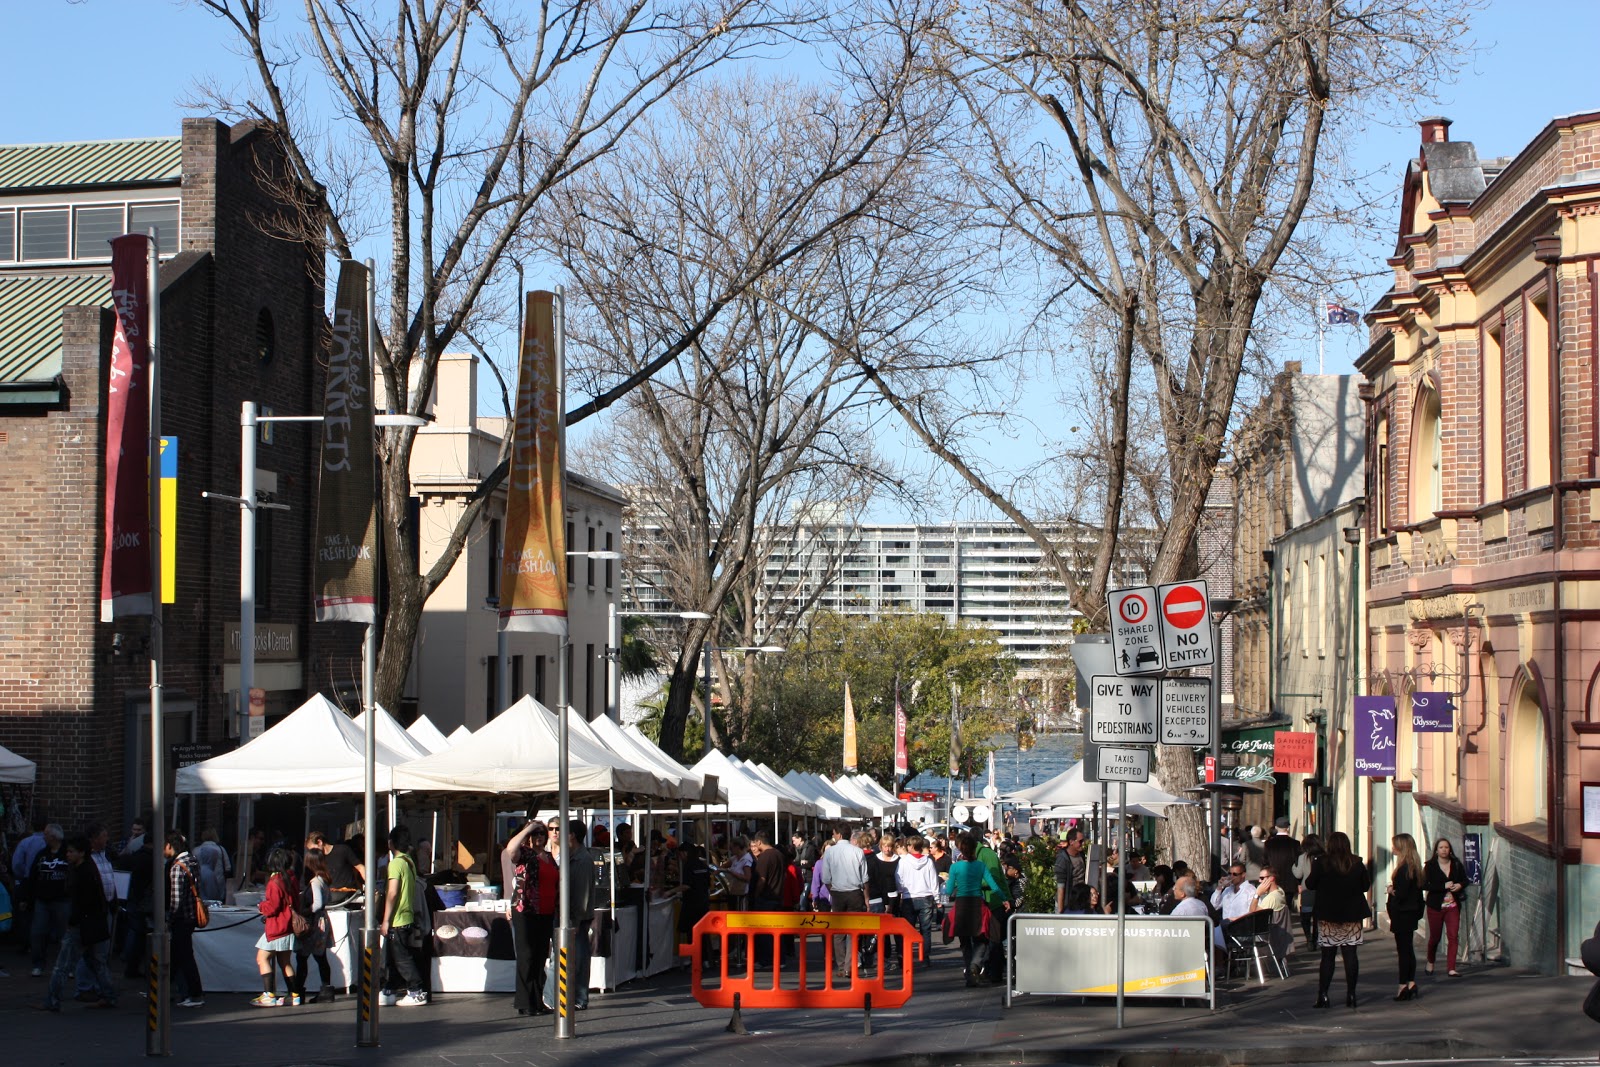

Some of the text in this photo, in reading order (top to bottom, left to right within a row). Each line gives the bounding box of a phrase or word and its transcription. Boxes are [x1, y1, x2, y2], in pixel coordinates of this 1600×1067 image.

[350, 307, 367, 410] The Rocks
[325, 308, 352, 472] MARKETS
[324, 534, 350, 546] TAKE A
[320, 545, 371, 561] FRESH LOOK
[513, 549, 545, 560] TAKE A
[507, 559, 538, 574] FRESH
[1126, 602, 1140, 616] 10
[1118, 624, 1154, 636] SHARED
[272, 631, 289, 651] Centre
[1125, 635, 1149, 646] ZONE
[1176, 632, 1199, 647] NO
[1169, 647, 1209, 662] ENTRY
[1097, 684, 1154, 697] GIVE WAY
[1165, 693, 1206, 702] DELIVERY
[1118, 703, 1132, 716] TO
[1166, 705, 1206, 714] VEHICLES
[1165, 717, 1207, 726] EXCEPTED
[1412, 717, 1440, 728] Odyssey
[1097, 722, 1153, 735] PEDESTRIANS
[1114, 755, 1134, 764] TAXIS
[1275, 759, 1313, 769] GALLERY
[1355, 760, 1382, 771] Odyssey
[1105, 766, 1142, 776] EXCEPTED
[1025, 927, 1191, 938] WINE ODYSSEY AUSTRALIA
